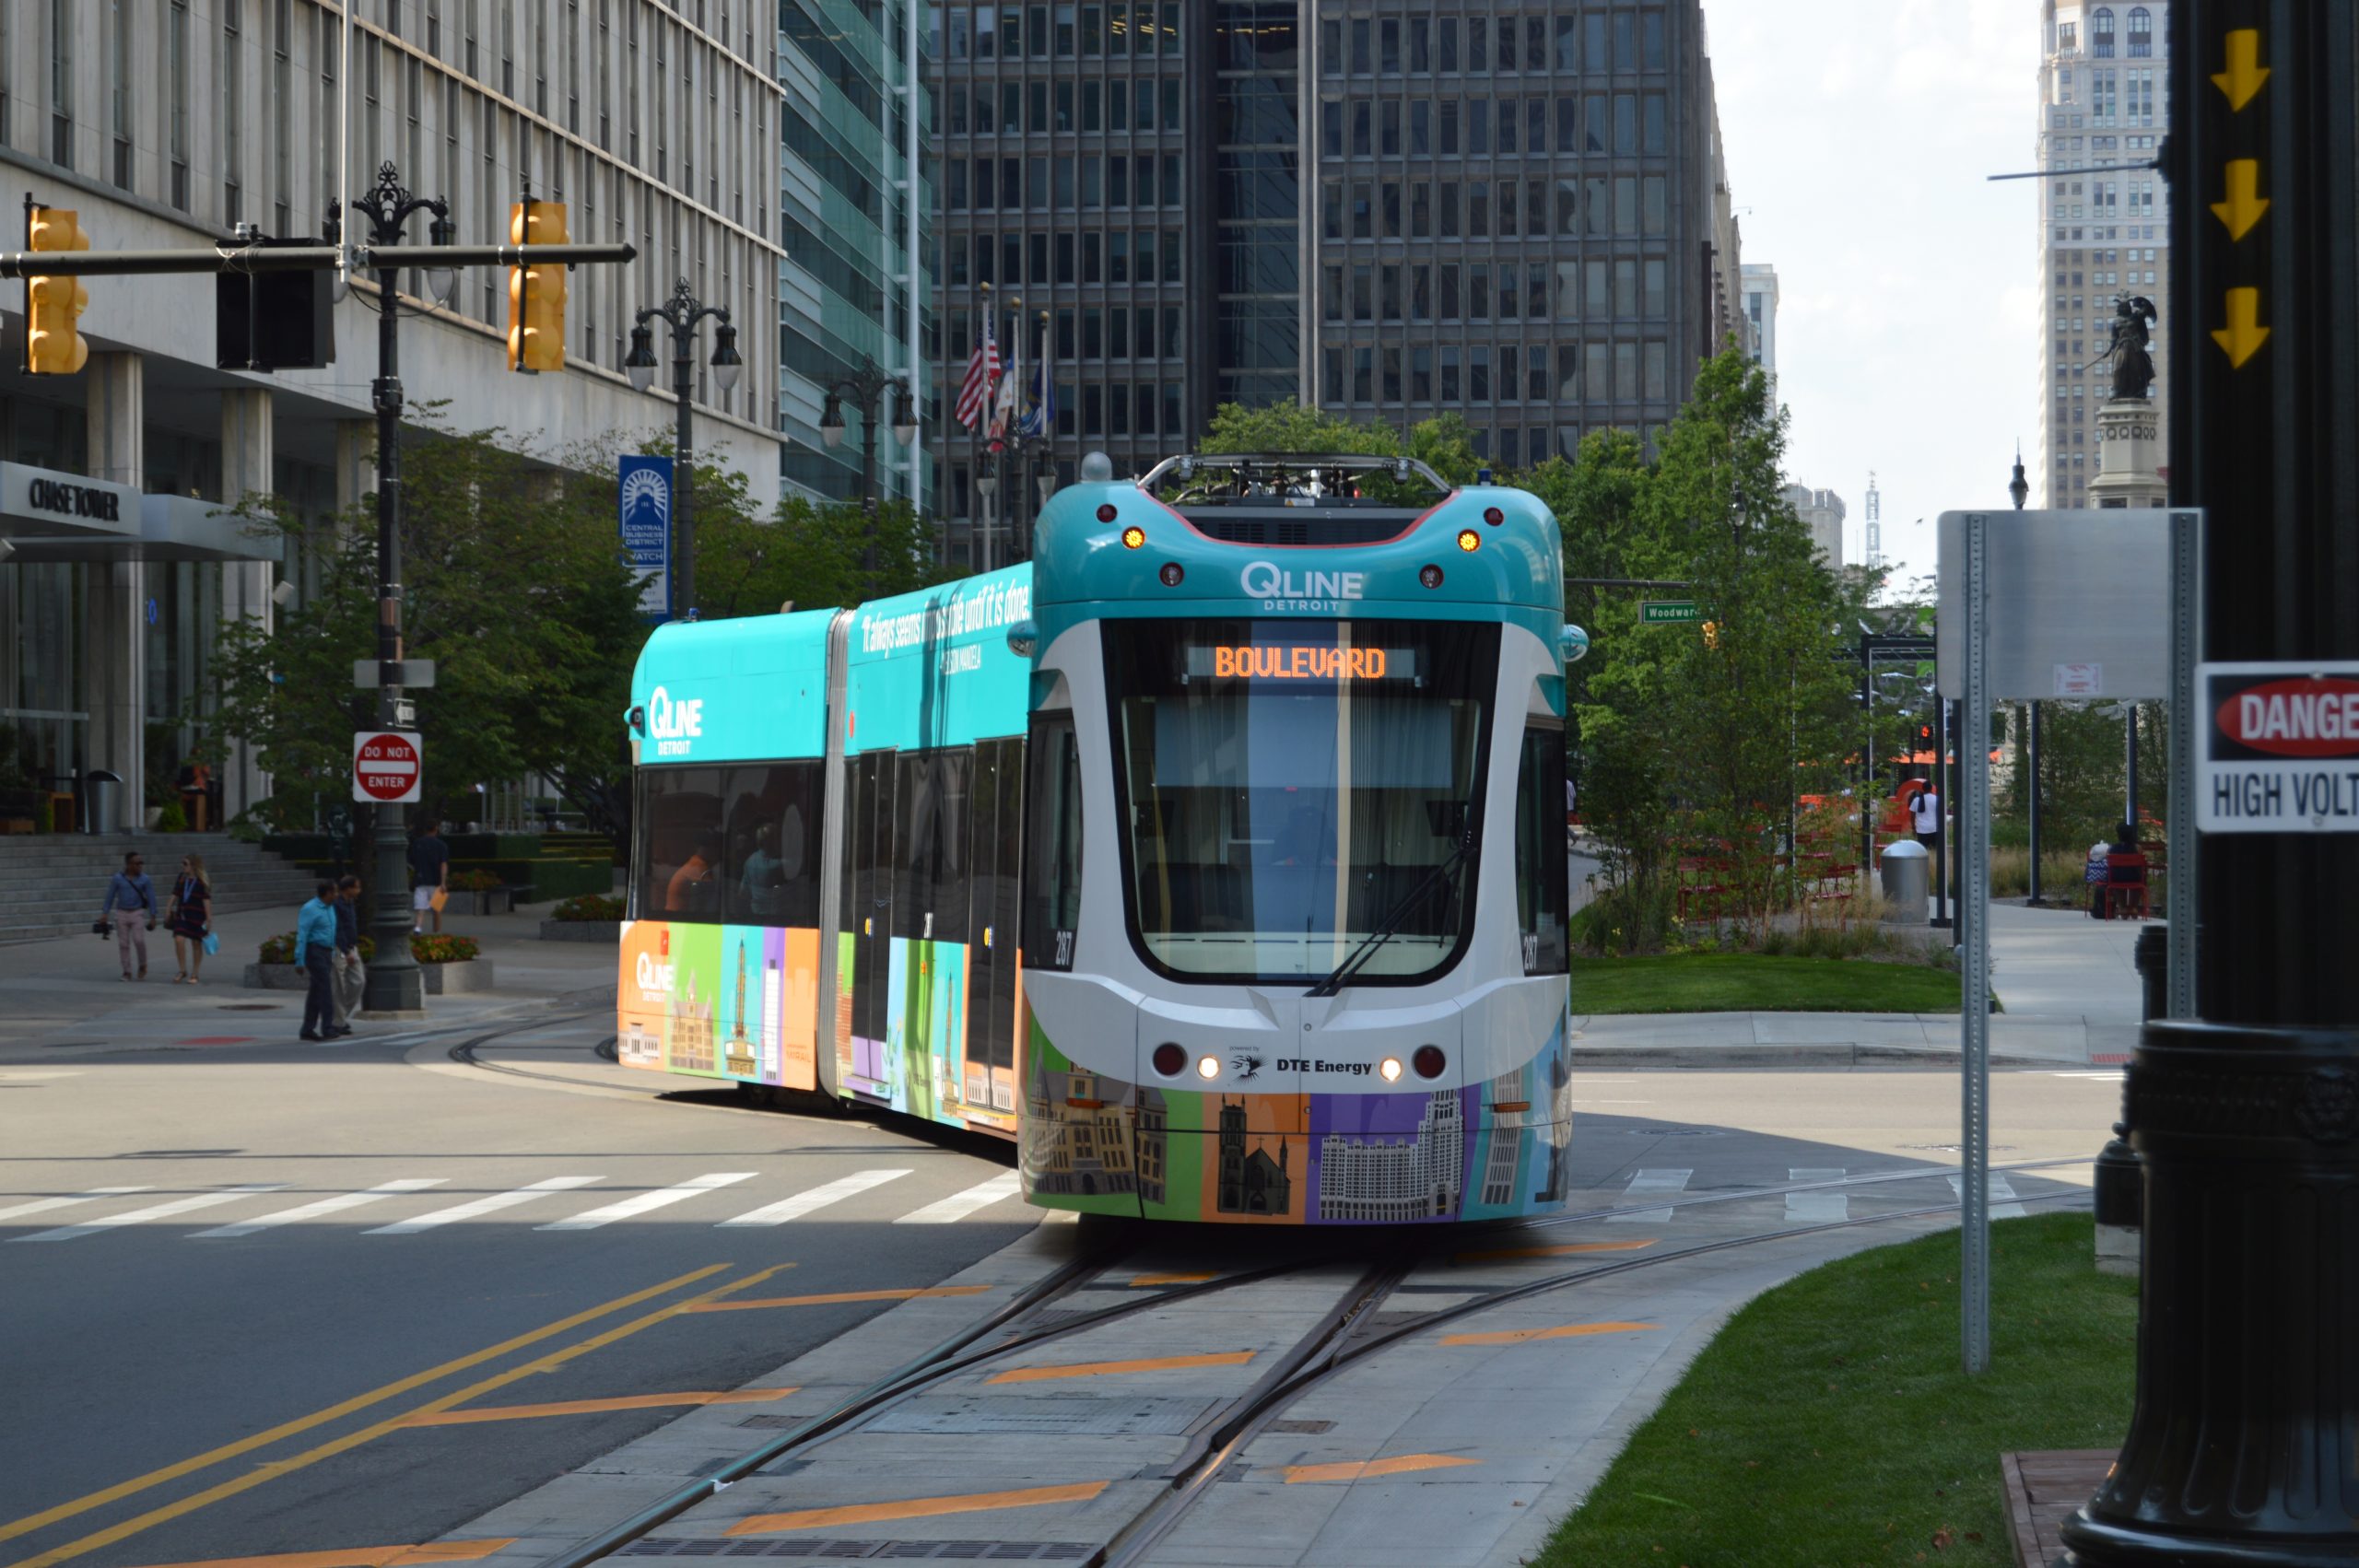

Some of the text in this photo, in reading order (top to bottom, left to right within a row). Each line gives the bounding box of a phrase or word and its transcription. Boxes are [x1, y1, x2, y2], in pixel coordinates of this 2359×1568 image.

[29, 477, 119, 521] CHASE TOWER
[1240, 560, 1363, 599] QLINE
[870, 611, 894, 659] always
[895, 611, 921, 648] seems
[965, 584, 989, 633] until
[994, 580, 1003, 626] is
[1264, 600, 1339, 611] DETROIT
[1649, 607, 1700, 617] Woodwar
[1215, 646, 1386, 679] BOULEVARD
[650, 685, 703, 740] QLINE
[364, 746, 410, 758] DO NOT
[658, 740, 691, 755] DETROIT
[368, 776, 405, 788] ENTER
[2213, 772, 2282, 817] HIGH
[1055, 930, 1073, 965] 287
[1523, 935, 1538, 970] 287
[636, 951, 674, 991] QLINE
[1276, 1059, 1372, 1076] DTE Energy
